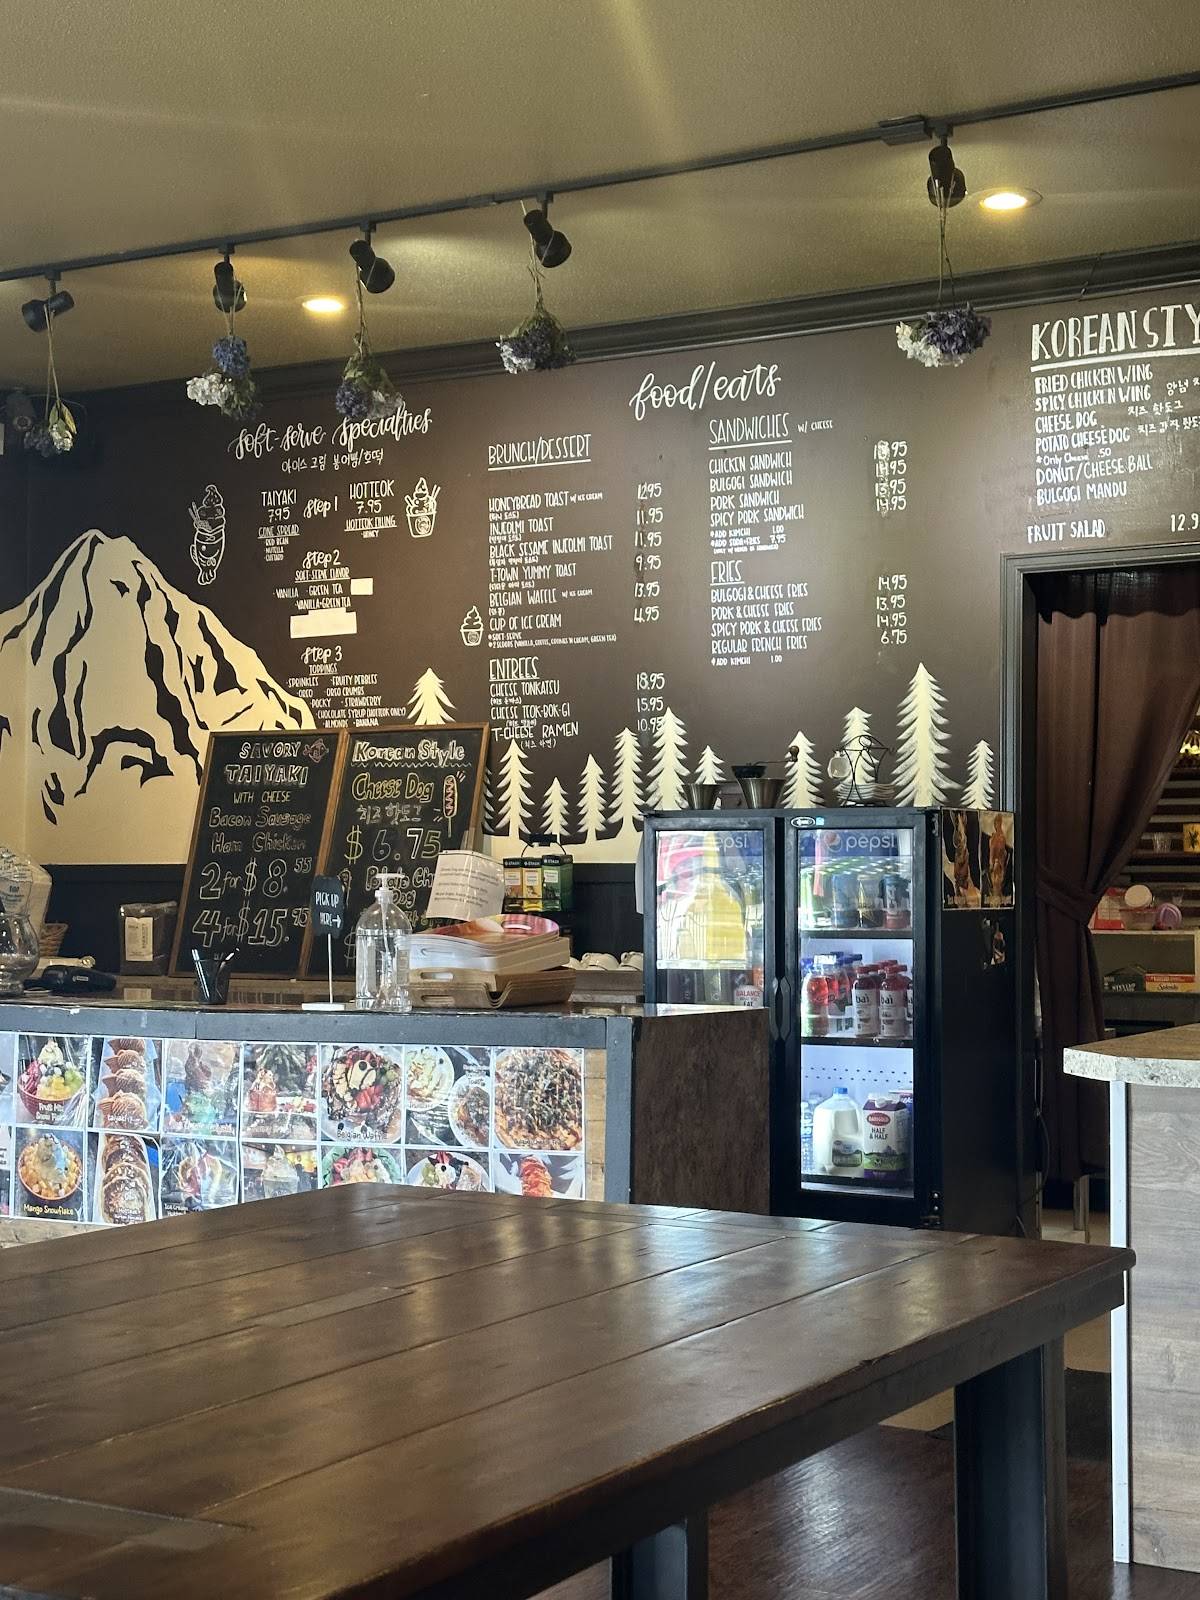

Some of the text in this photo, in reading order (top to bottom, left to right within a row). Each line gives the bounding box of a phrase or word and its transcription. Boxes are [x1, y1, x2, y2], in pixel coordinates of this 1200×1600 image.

[1032, 310, 1137, 361] KOREAN
[1034, 364, 1153, 394] FRIED CHICKEN WING
[629, 361, 781, 420] food/eats
[1035, 385, 1151, 412] SPICY CHICKEN WING
[228, 401, 432, 460] soft-serve specialties
[709, 412, 790, 444] SANDWICHES
[1035, 411, 1098, 433] CHEESE DOG
[488, 434, 592, 466] BRUNCH/DESSERT
[1035, 427, 1131, 454] POTATO CHEESE DOG
[709, 451, 792, 474] CHICKEN SANDWICH
[1128, 454, 1153, 473] BALL
[350, 480, 395, 500] HOTTEOK
[710, 470, 793, 492] BULGOGI SANDWICH
[261, 489, 297, 506] TAIYAKI
[489, 491, 569, 512] HONEYBREAD TOAST
[710, 490, 780, 510] PORK SANDWICH
[1037, 481, 1128, 506] BULGOGI MANDU
[304, 498, 332, 518] step
[356, 500, 382, 514] 7.95
[876, 496, 906, 512] 14.95
[268, 507, 290, 522] 7.95
[636, 507, 664, 525] 11.95
[710, 503, 805, 527] SPICY PORK SANDWICH
[276, 524, 300, 536] SPREAD
[490, 517, 554, 536] INJEOLMI TOAST
[1027, 519, 1106, 544] FRUIT SALAD
[490, 535, 613, 559] BLACK SESAME INJEOLMI TOAST
[634, 531, 662, 548] 11.95
[302, 549, 340, 569] step 2
[636, 555, 662, 572] 9.95
[490, 562, 576, 582] T-TOWN YUMMY TOAST
[711, 560, 742, 583] FRIES
[276, 583, 343, 598] VANILLA GREEN TEA
[634, 581, 660, 598] 13.95
[878, 574, 907, 591] 14.95
[490, 588, 558, 607] BELGIAN WAFFLE
[711, 583, 808, 602] BULGOGI CHEESE FRIES
[712, 602, 794, 620] PORK CHEESE FRIES
[876, 595, 906, 610] 13.95
[490, 614, 562, 632] CUP OF ICE CREAM
[634, 606, 660, 623] 4.95
[876, 612, 906, 628] 14.95
[711, 617, 822, 638] SPICY PORK CHEESE FRIES
[880, 629, 907, 645] 6.75
[712, 636, 808, 654] REGULAR FRENCH FRIES
[300, 646, 342, 664] step 3
[309, 663, 338, 674] TOPPINGS
[489, 656, 539, 680] ENTREES
[490, 680, 560, 698] CHEESE TONKATSU
[636, 672, 665, 690] 18.95
[490, 706, 518, 720] CHEESE
[637, 696, 664, 712] 15.95
[491, 721, 578, 741] T-CHEESE RAMEN
[239, 741, 301, 759] SAVORY
[352, 738, 465, 768] Korean Style
[225, 764, 308, 785] TAIYAKI
[234, 790, 292, 804] WITH CHEESE
[352, 772, 434, 804] Cheese Dog
[209, 806, 252, 828] Bacon
[846, 832, 895, 852] pepsi
[200, 862, 243, 900] 2 for
[316, 890, 340, 908] PICK UP
[192, 910, 238, 948] 4 for
[880, 994, 894, 1004] bai
[24, 1204, 42, 1214] Mango
